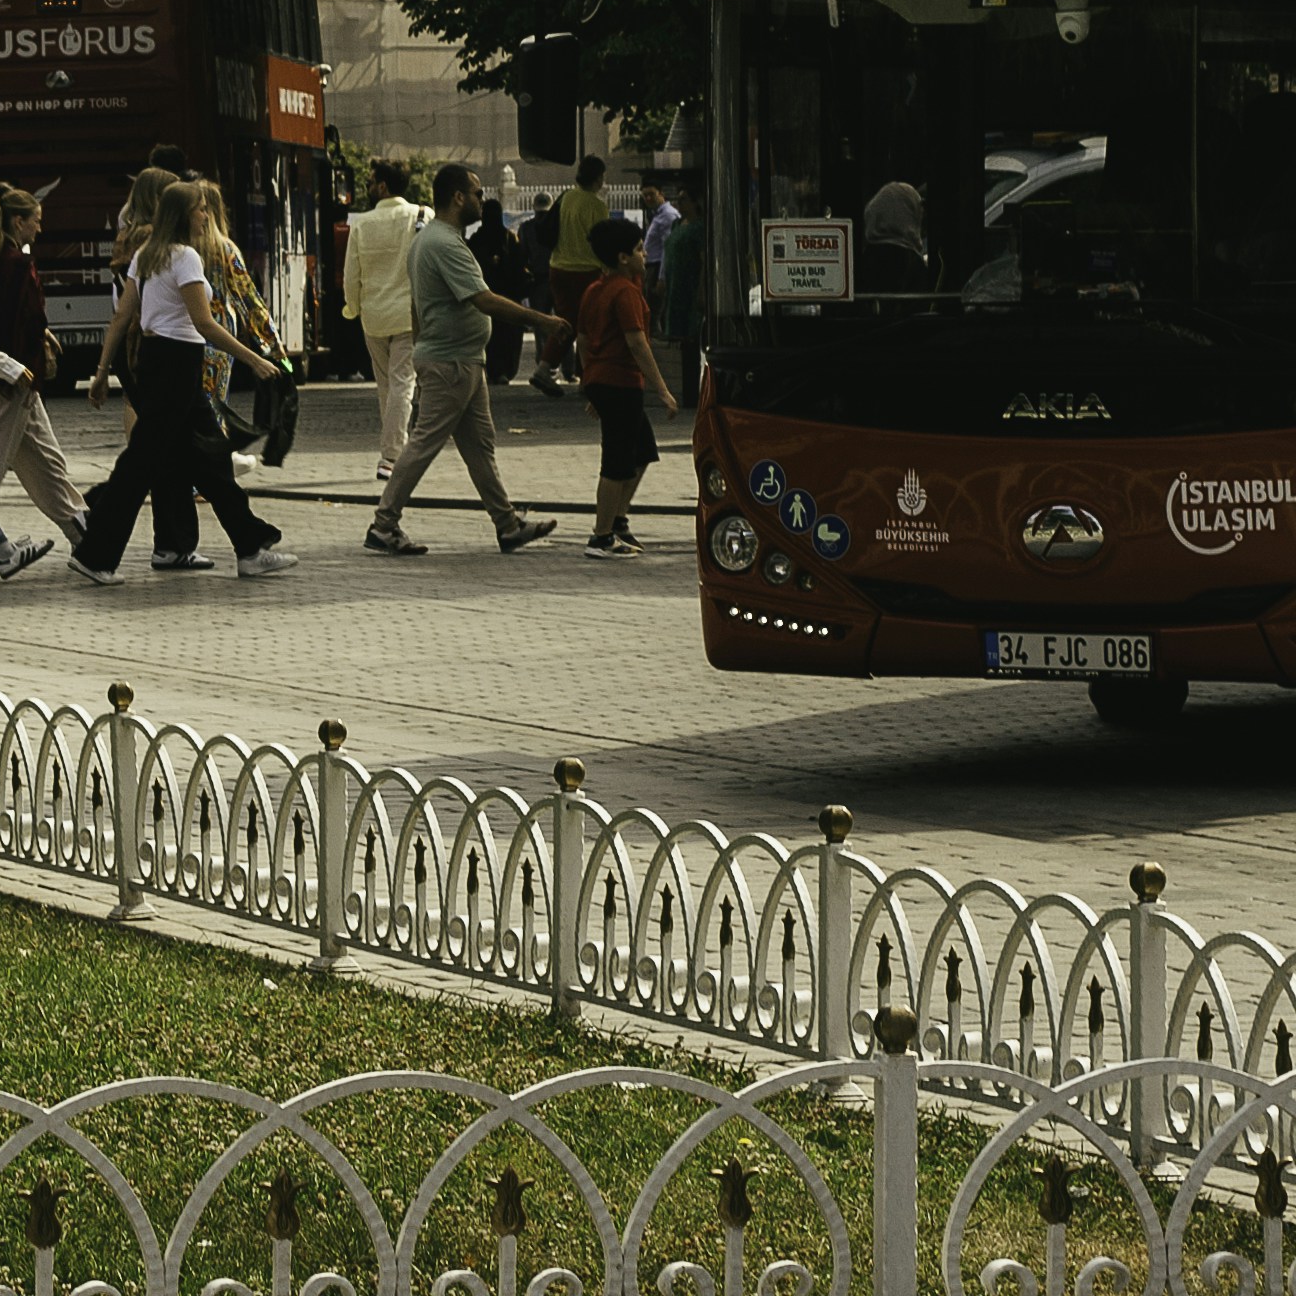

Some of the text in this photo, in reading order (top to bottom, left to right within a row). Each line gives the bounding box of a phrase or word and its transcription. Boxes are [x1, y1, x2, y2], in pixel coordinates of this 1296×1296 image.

[15, 100, 32, 112] ON
[35, 99, 60, 111] HOP
[64, 98, 86, 110] OFF
[89, 96, 128, 109] TOURS
[791, 278, 823, 288] TRAVEL
[1002, 392, 1112, 419] AKIA
[1179, 471, 1296, 504] İSTANBUL
[1000, 635, 1148, 668] 34 FJC 086
